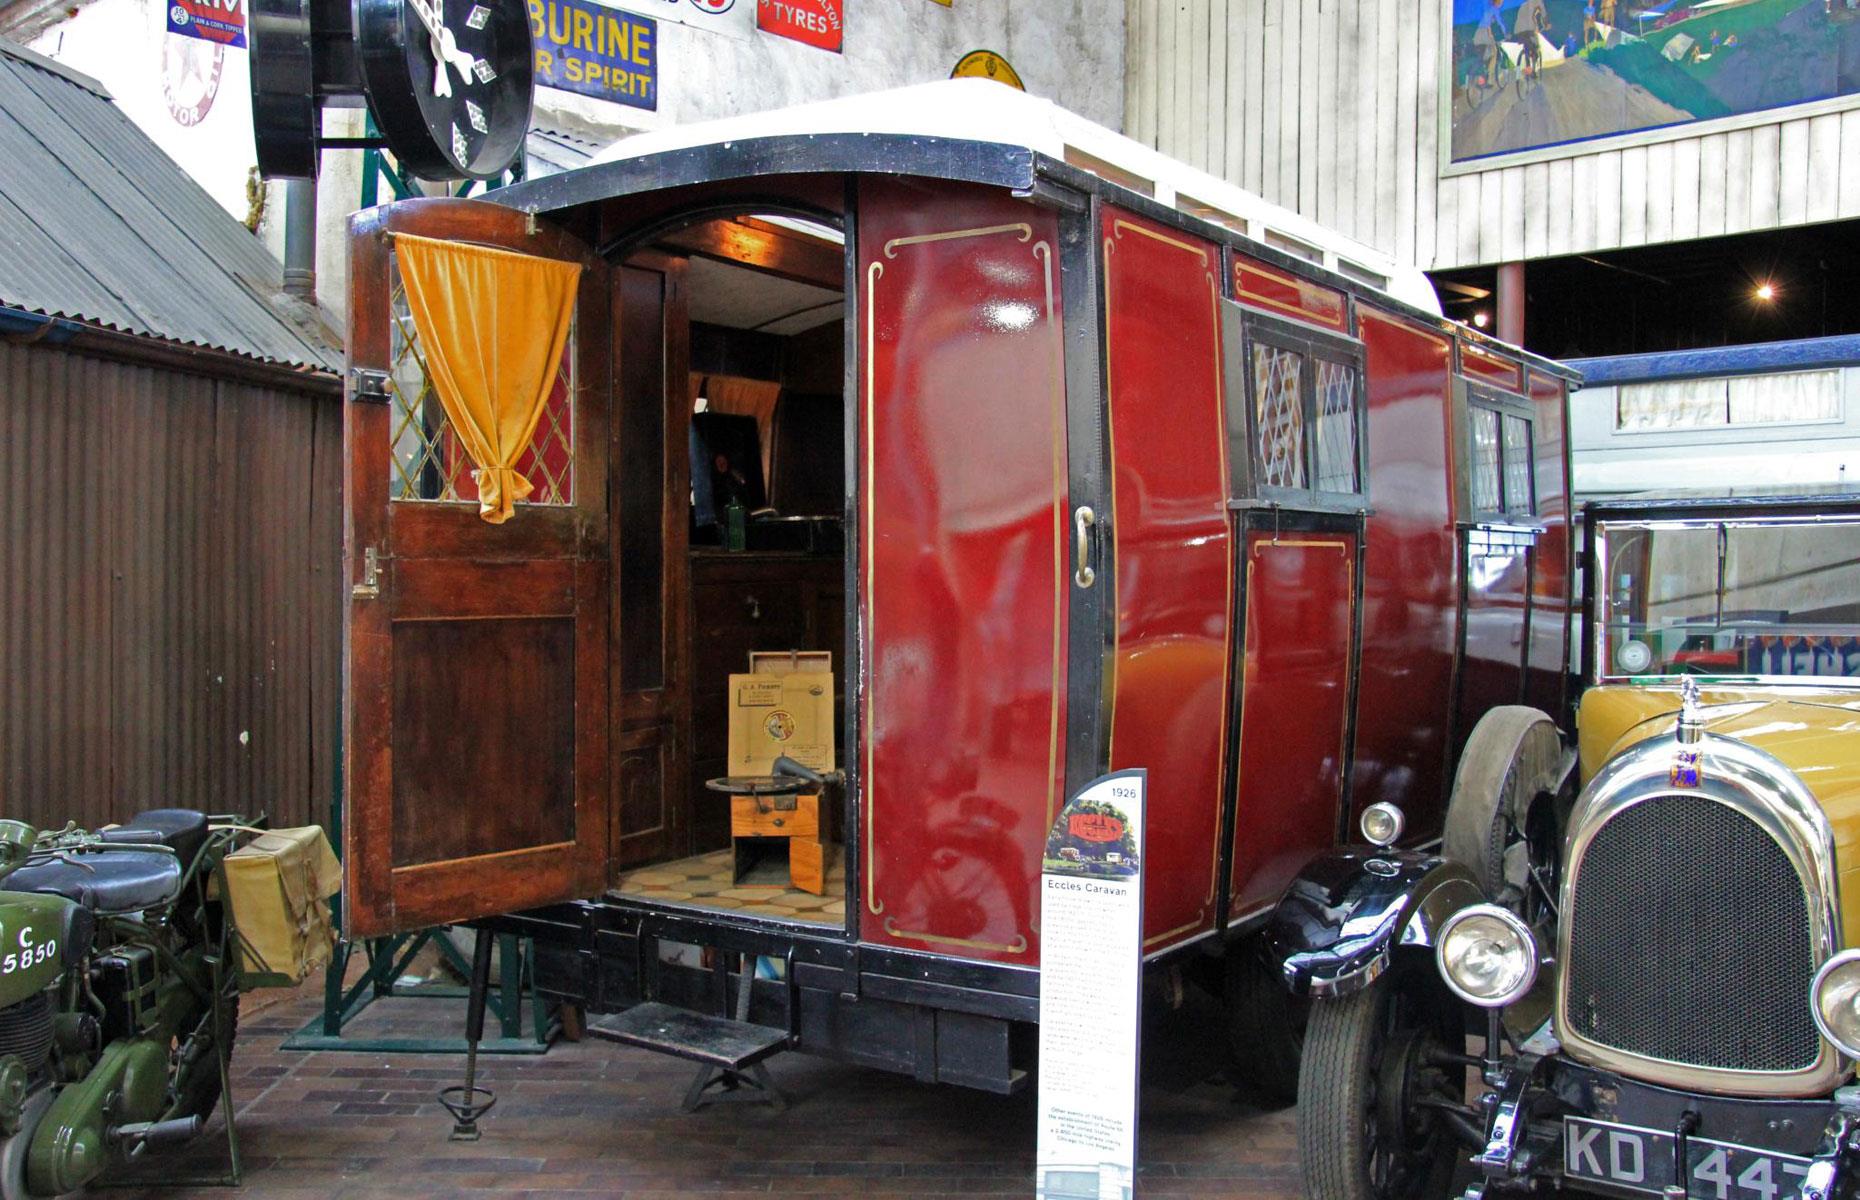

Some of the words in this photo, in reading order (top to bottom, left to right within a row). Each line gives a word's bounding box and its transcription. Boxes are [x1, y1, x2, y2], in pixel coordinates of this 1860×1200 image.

[773, 1, 828, 34] TYRES
[564, 57, 652, 98] SPIRIT
[1112, 788, 1137, 799] 1926
[1048, 880, 1081, 891] Eccles
[1085, 883, 1127, 896] Caravan
[19, 926, 33, 948] C
[2, 939, 56, 974] 5850
[1568, 1123, 1645, 1183] KD
